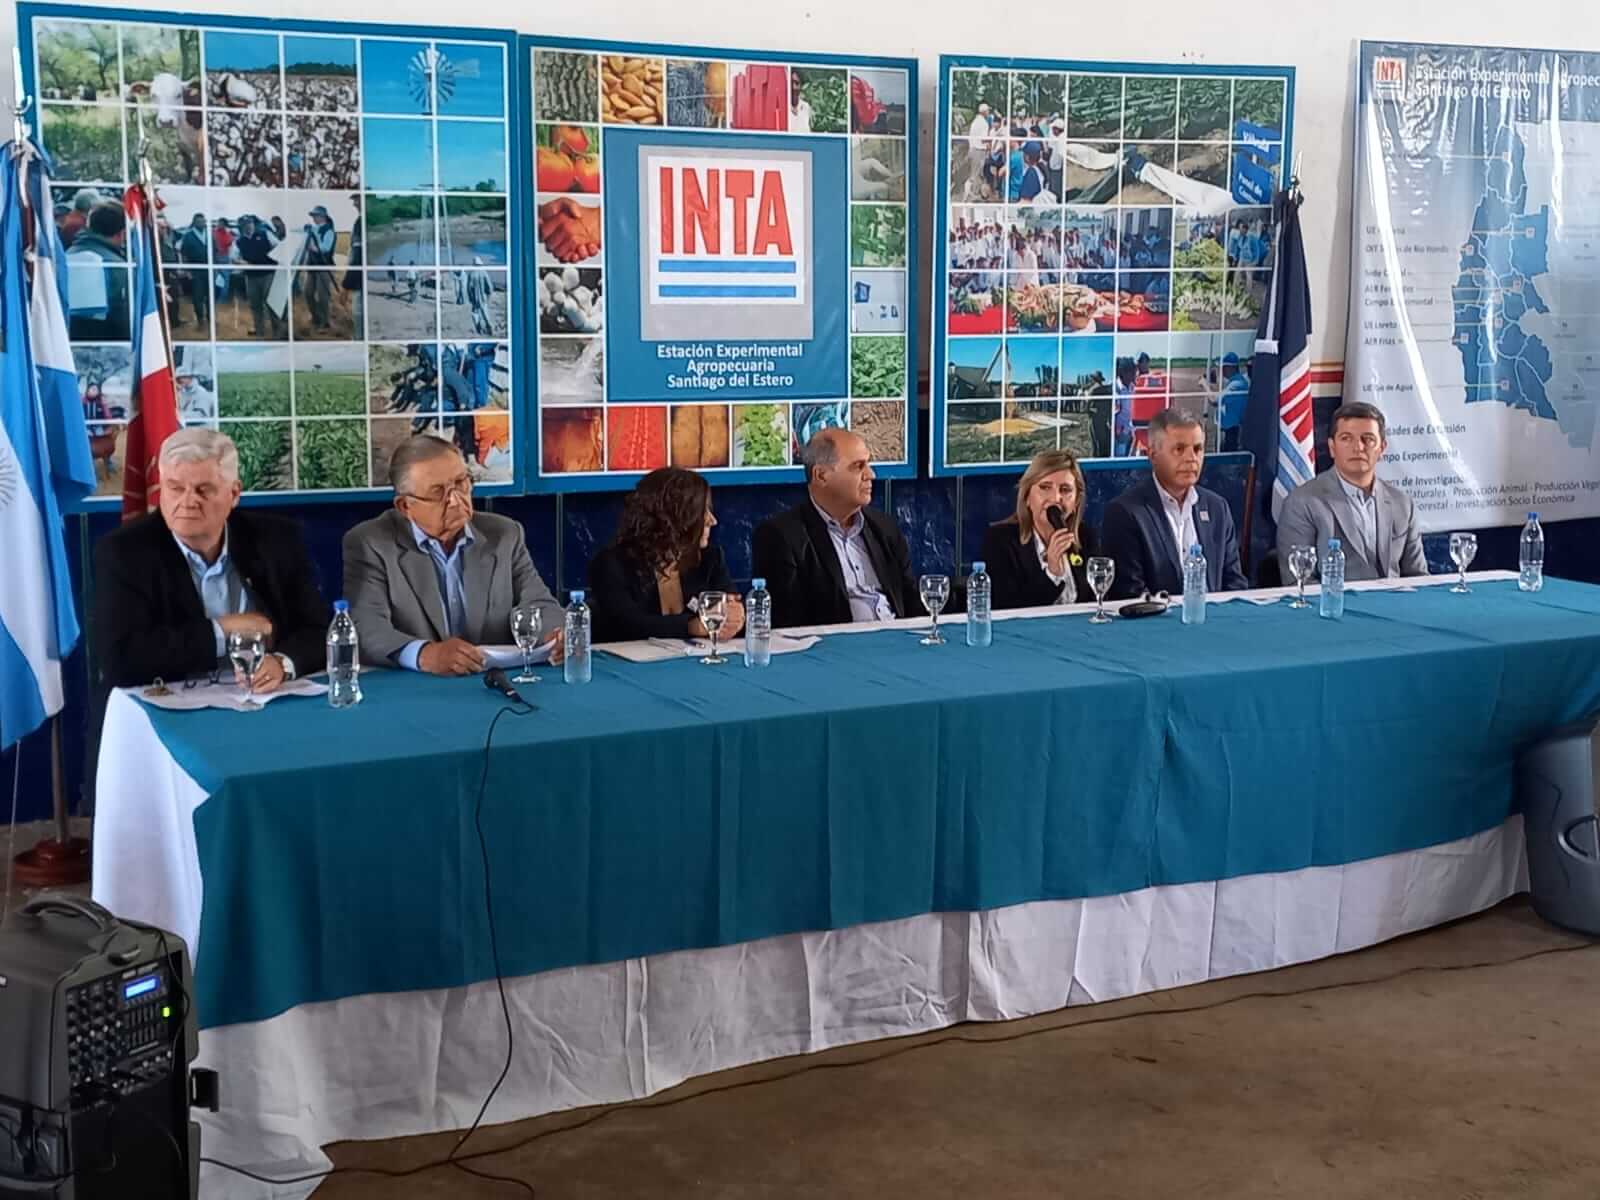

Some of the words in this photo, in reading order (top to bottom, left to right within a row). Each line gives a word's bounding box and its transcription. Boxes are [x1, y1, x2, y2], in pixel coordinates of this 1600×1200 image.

[1376, 61, 1402, 80] INTA
[660, 167, 793, 255] INTA
[657, 343, 714, 359] Estación
[716, 344, 803, 360] Experimental
[687, 358, 776, 375] Agropecuaria
[667, 374, 726, 390] Santiago
[729, 373, 749, 387] del
[753, 373, 794, 386] Estero
[1413, 424, 1425, 435] de
